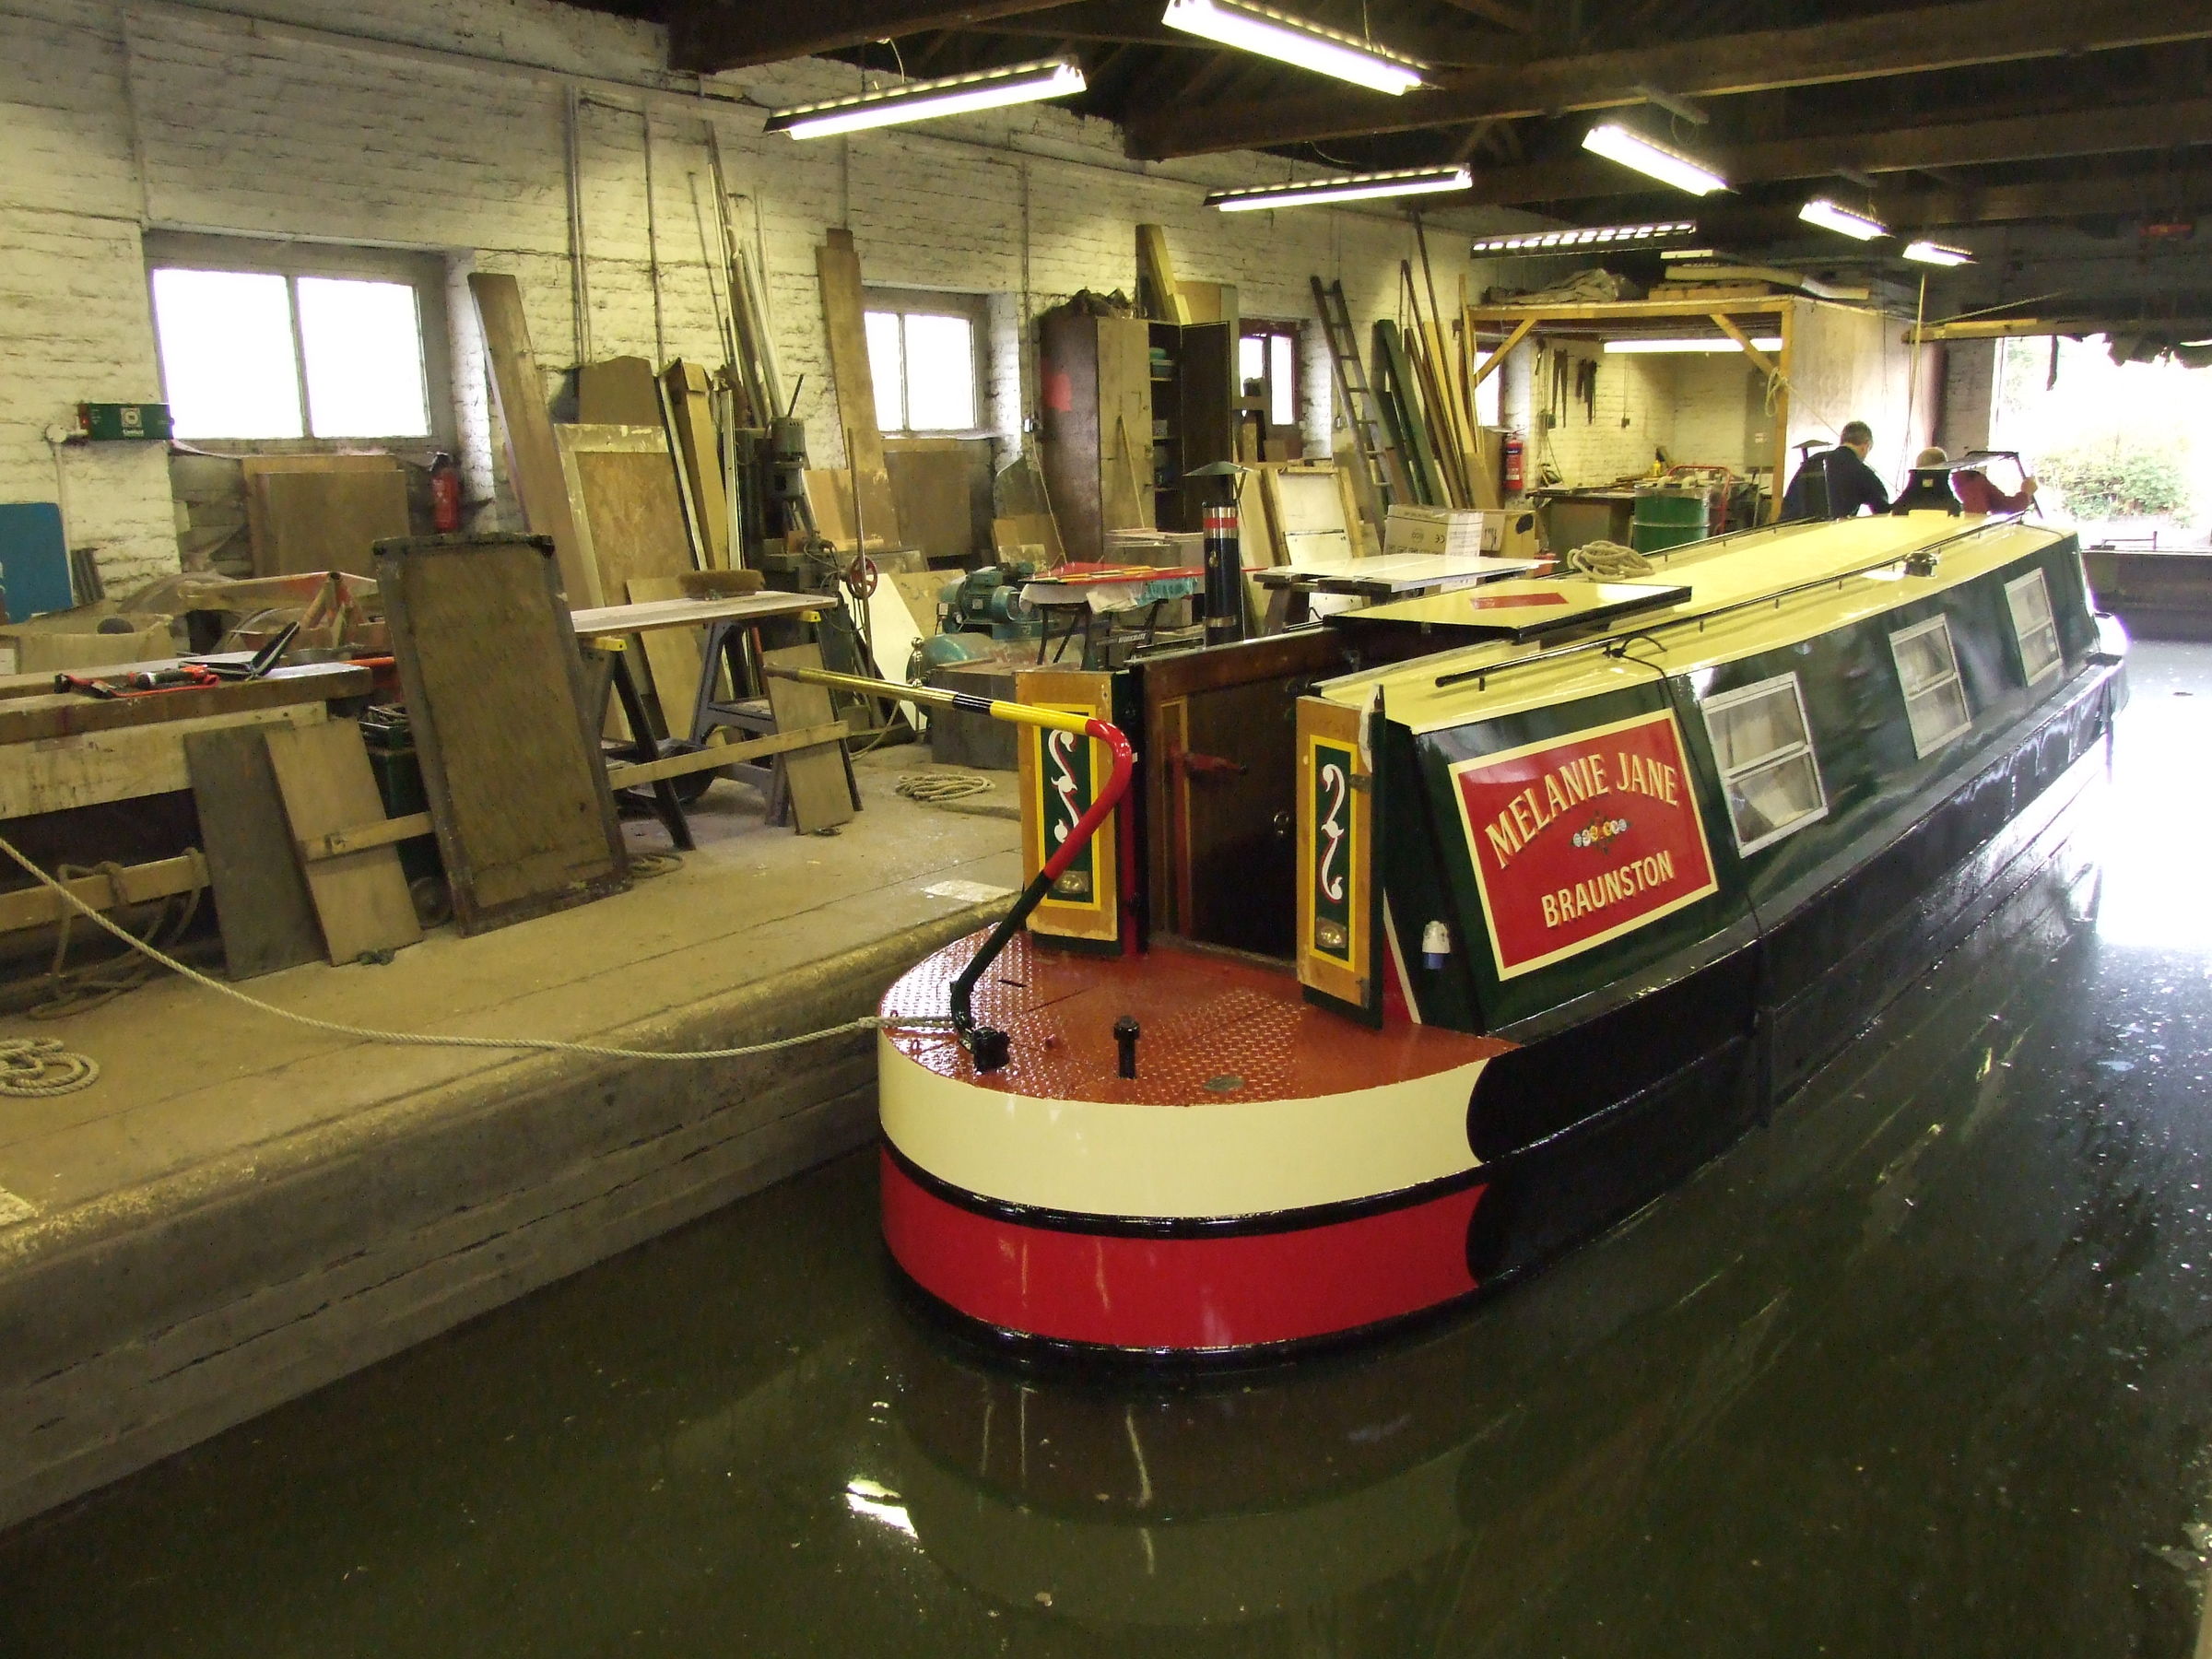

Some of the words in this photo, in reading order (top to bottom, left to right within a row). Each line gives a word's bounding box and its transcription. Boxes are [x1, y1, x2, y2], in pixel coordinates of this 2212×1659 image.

[1485, 754, 1609, 870] MELANIE
[1617, 751, 1678, 806] JANE
[1541, 850, 1676, 928] BRAUNSTON
